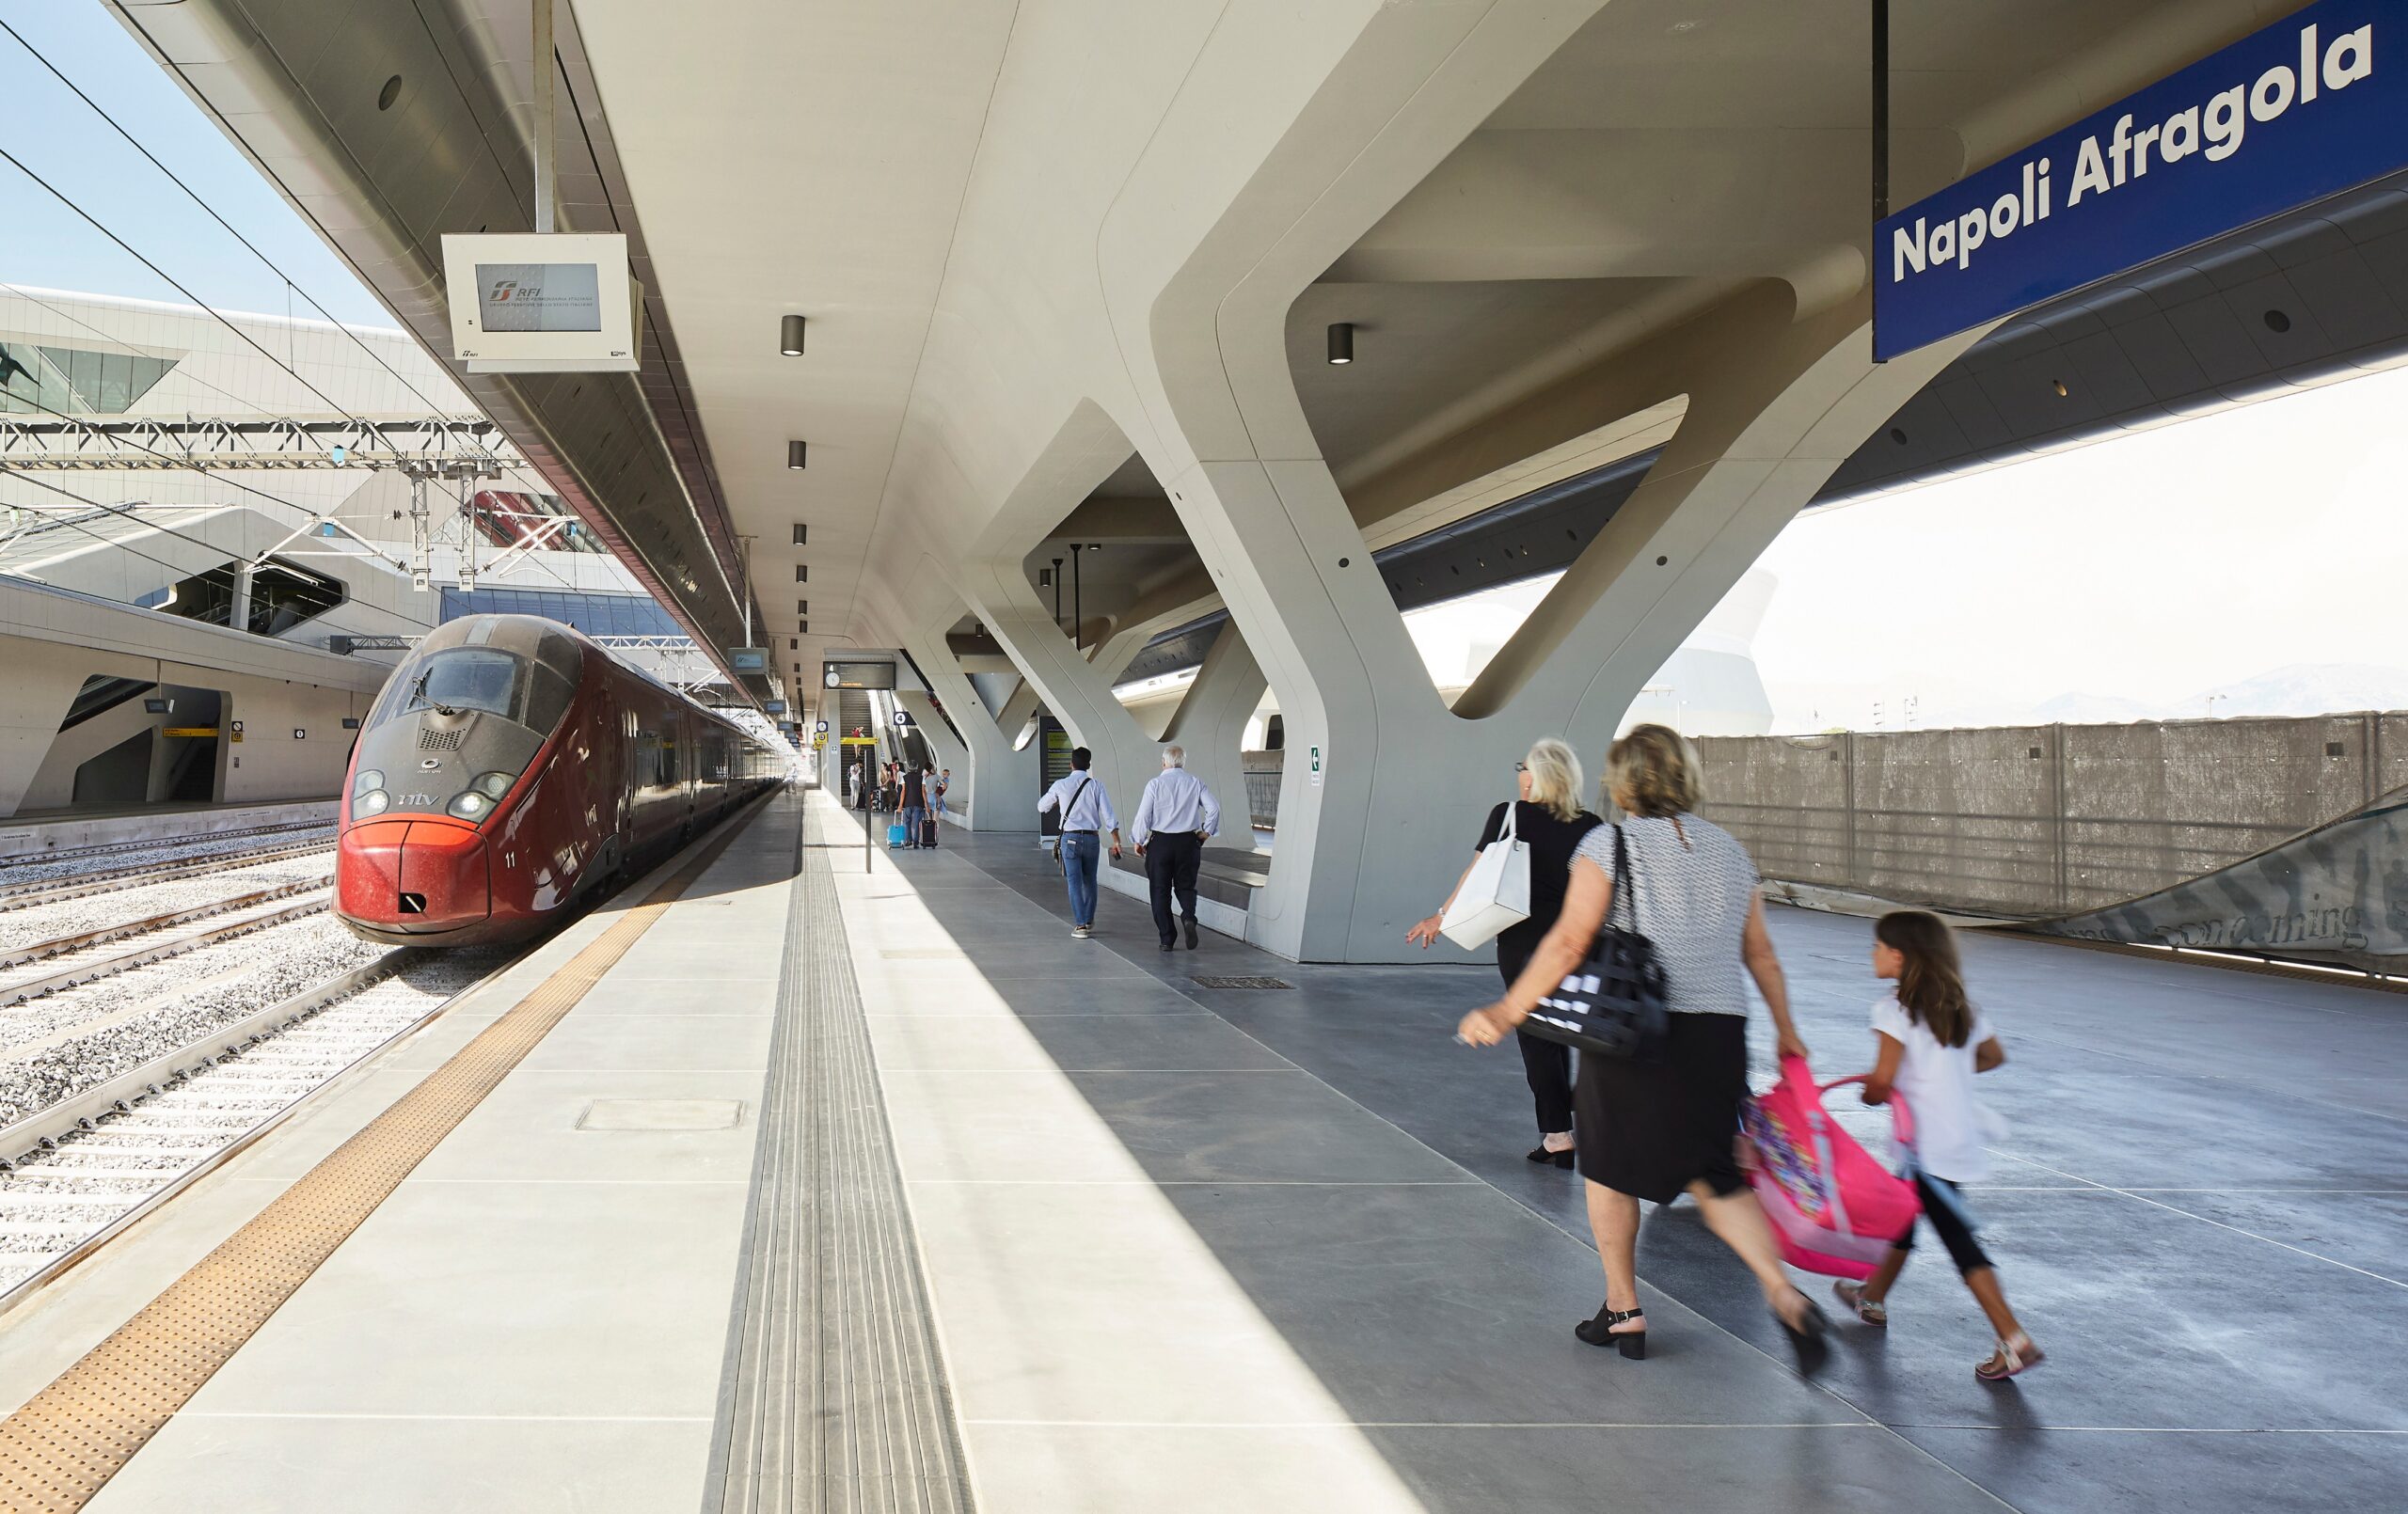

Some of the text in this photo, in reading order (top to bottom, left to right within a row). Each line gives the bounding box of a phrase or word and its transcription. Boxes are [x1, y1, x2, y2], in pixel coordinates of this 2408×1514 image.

[1893, 24, 2372, 283] Napoli Afragola
[517, 288, 542, 296] RFI
[505, 851, 515, 869] 11
